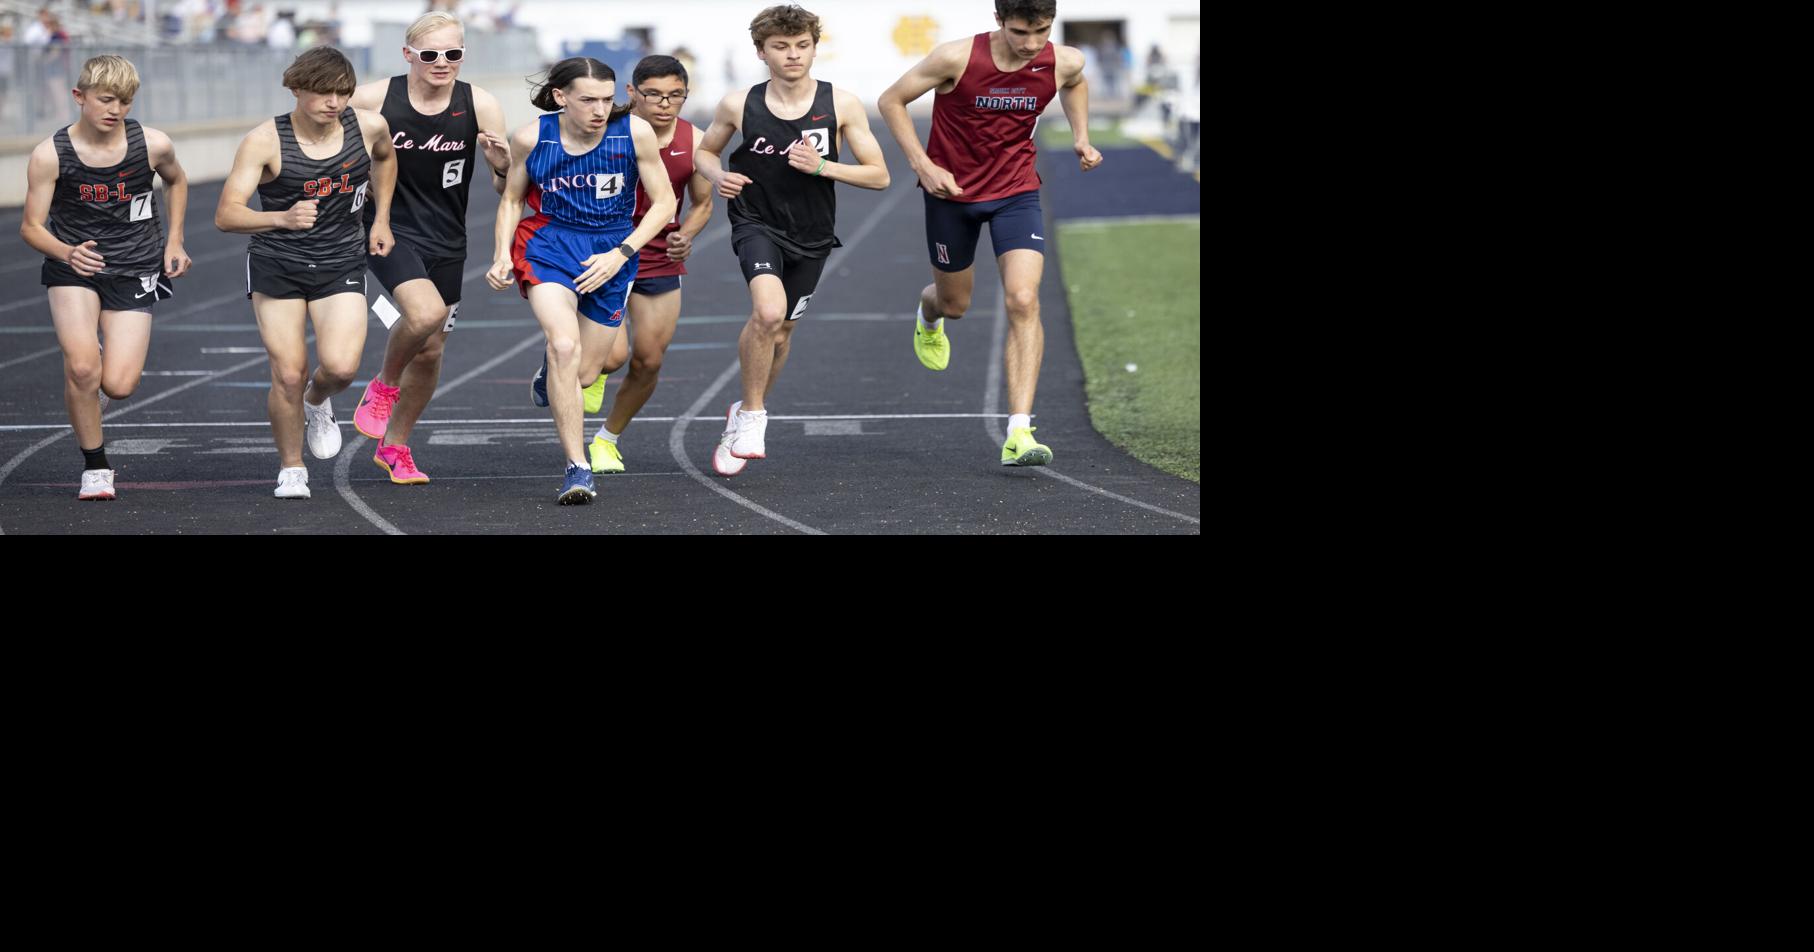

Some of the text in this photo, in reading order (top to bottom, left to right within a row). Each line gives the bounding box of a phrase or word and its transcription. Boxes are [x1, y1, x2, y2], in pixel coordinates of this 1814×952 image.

[975, 95, 1037, 111] NORTH
[418, 134, 466, 152] Mars
[749, 137, 775, 154] Le
[808, 132, 824, 152] 2
[446, 161, 461, 184] 5
[79, 182, 132, 203] SB-L
[303, 173, 354, 197] SB-L
[600, 176, 618, 194] 4
[134, 194, 149, 217] 7
[935, 242, 950, 264] N
